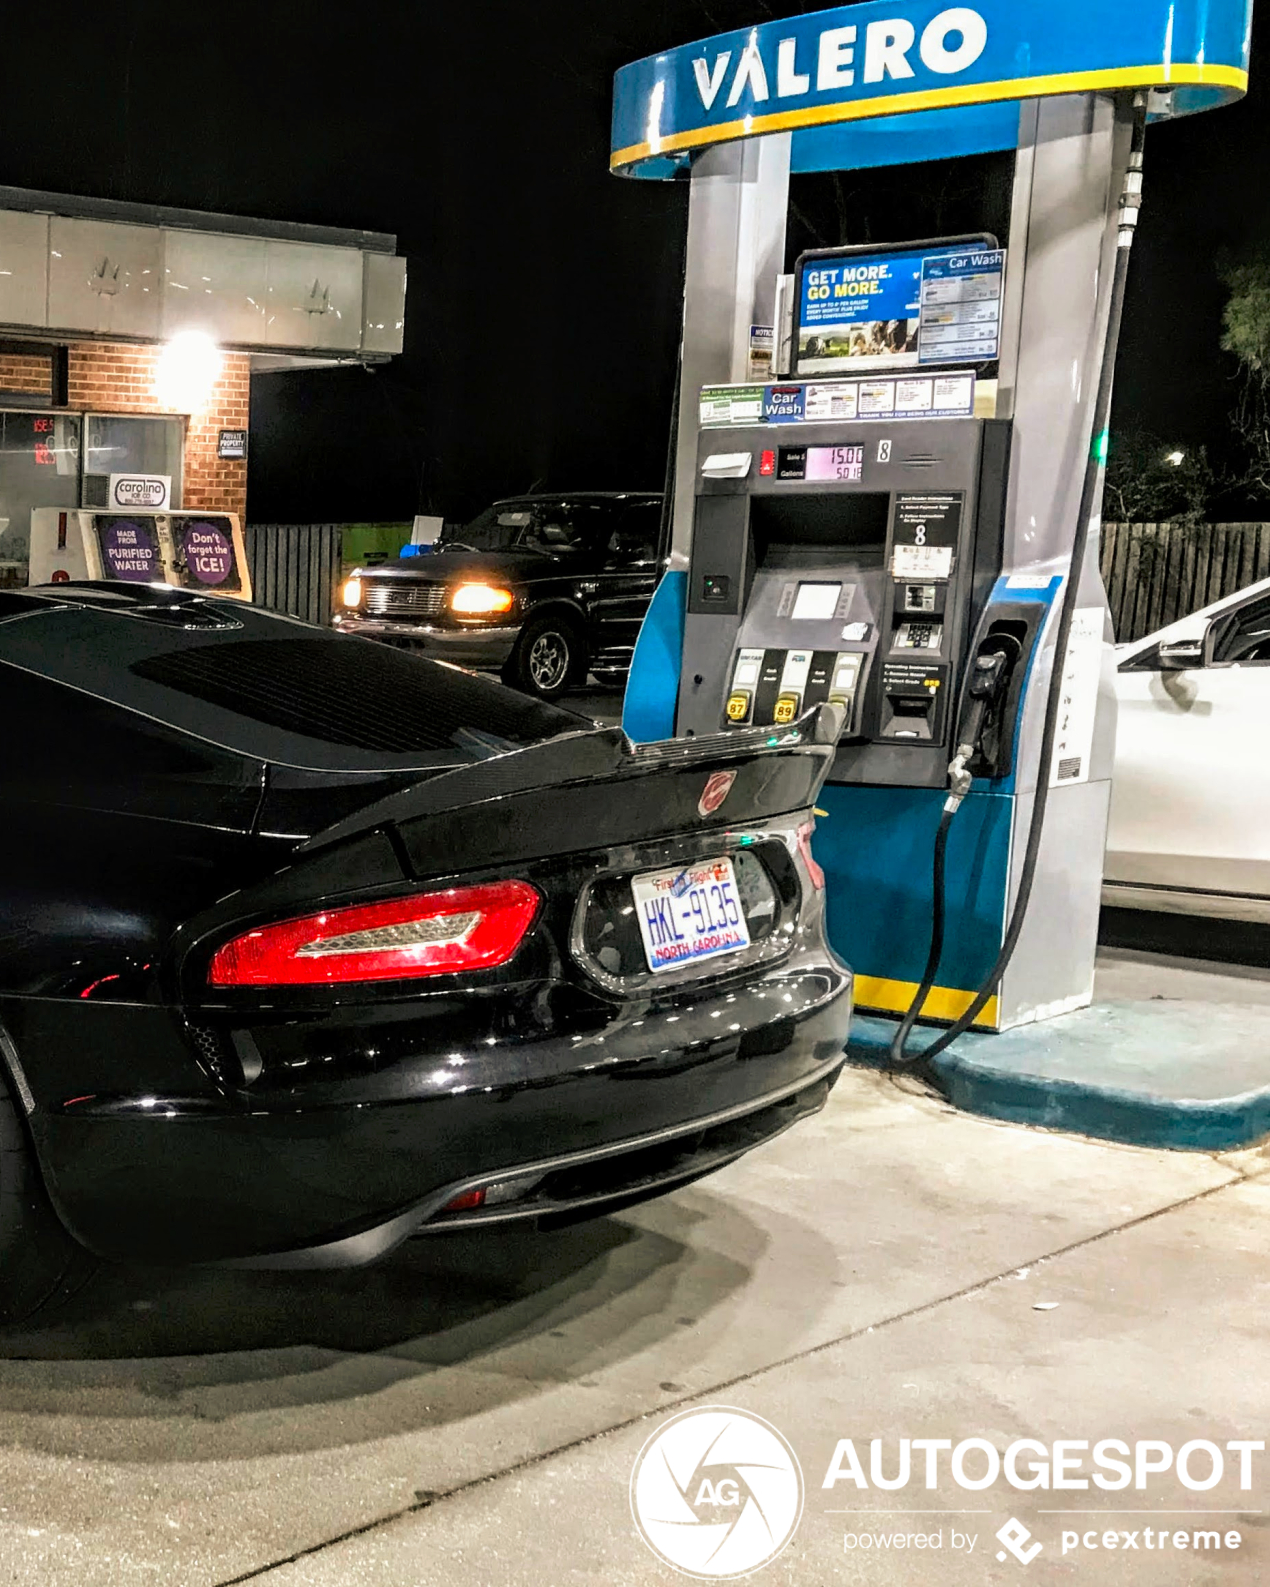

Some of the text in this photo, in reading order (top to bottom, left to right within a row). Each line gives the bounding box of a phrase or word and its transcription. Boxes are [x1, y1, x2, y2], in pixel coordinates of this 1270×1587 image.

[691, 7, 987, 110] VALERO
[949, 253, 1001, 268] Car Wash
[808, 270, 839, 285] GET
[843, 265, 893, 283] MORE.
[808, 280, 884, 300] GO MORE.
[772, 393, 796, 404] Car
[765, 404, 802, 415] Wash
[880, 442, 889, 461] 8
[120, 480, 161, 493] carolina
[117, 530, 136, 538] MADE
[192, 532, 220, 544] Don't
[915, 524, 926, 545] 8
[118, 537, 137, 545] FROM
[108, 548, 153, 559] PURIFIED
[188, 544, 228, 555] forget the
[114, 560, 149, 571] WATER
[195, 557, 225, 573] ICE!
[730, 704, 744, 714] 87
[777, 706, 792, 717] 89
[644, 882, 740, 947] HKL-9135
[655, 932, 740, 961] NORTH CAROLINA
